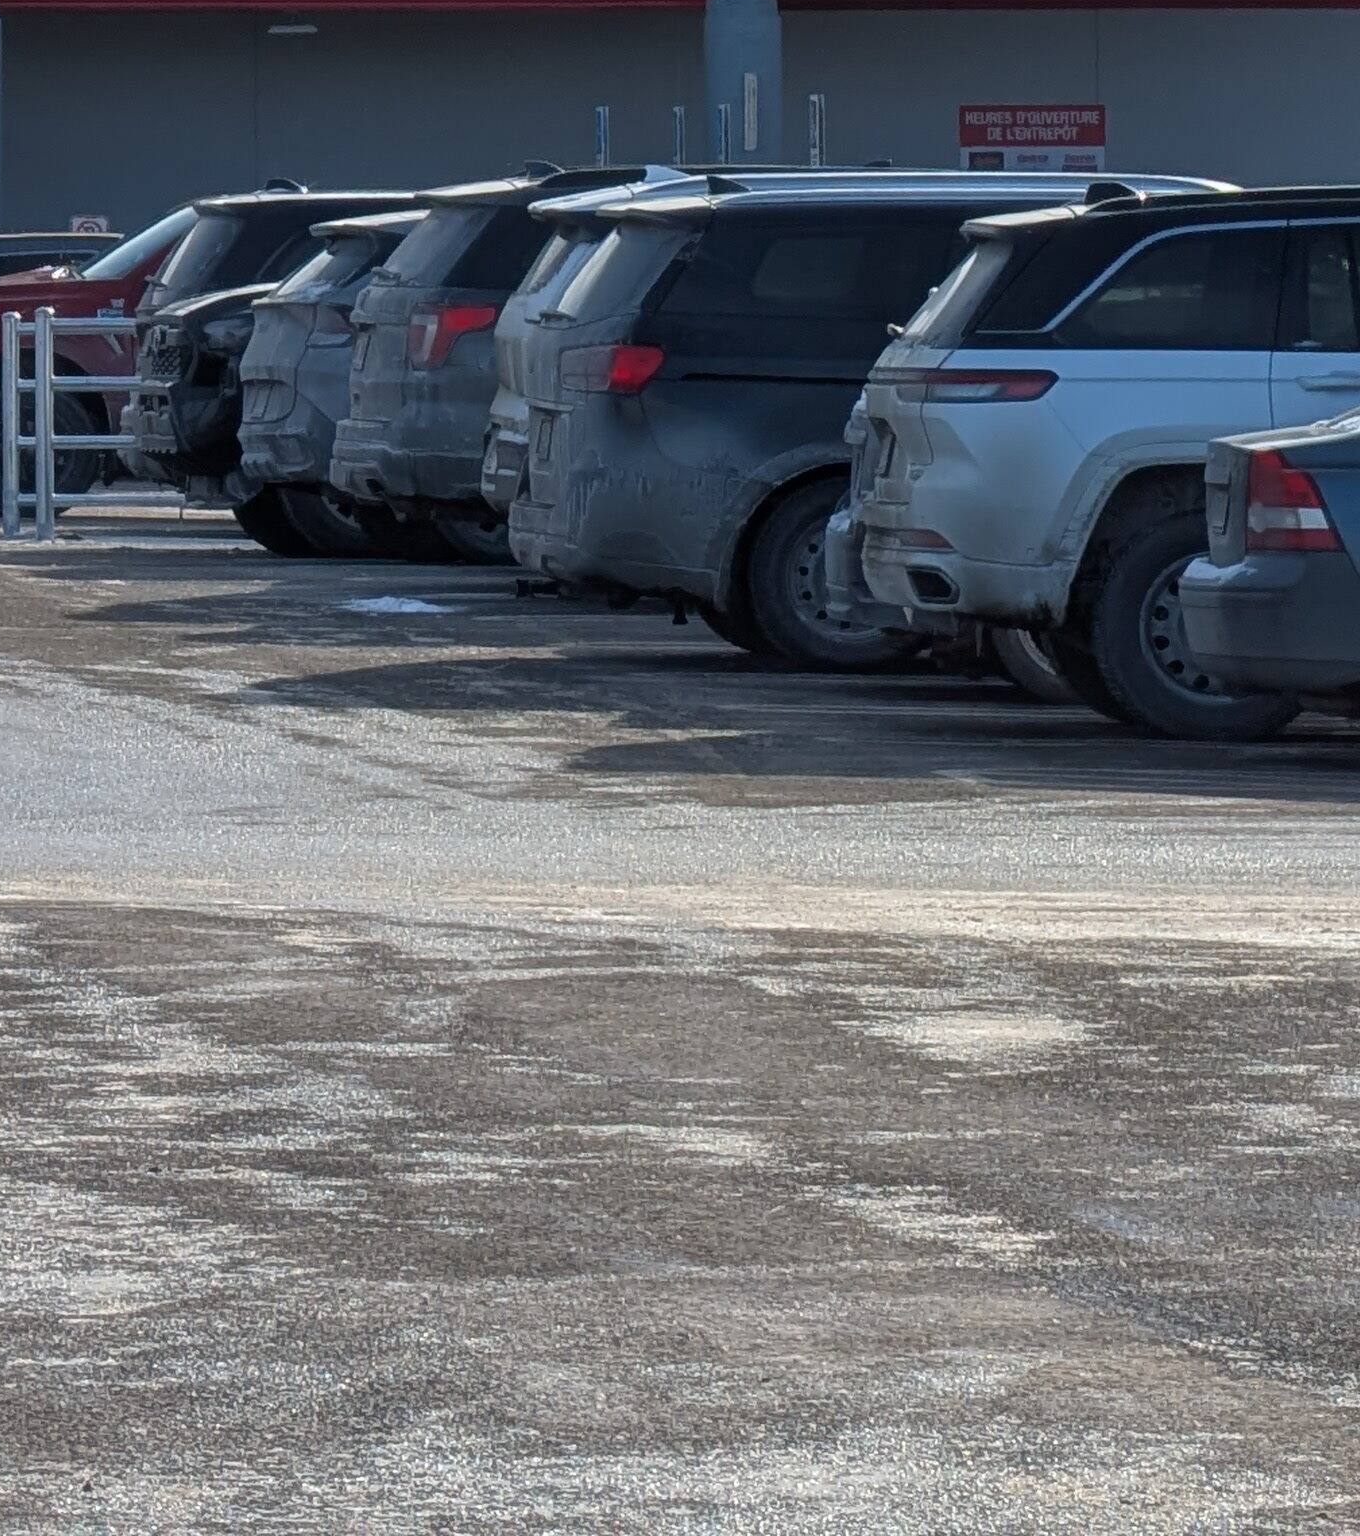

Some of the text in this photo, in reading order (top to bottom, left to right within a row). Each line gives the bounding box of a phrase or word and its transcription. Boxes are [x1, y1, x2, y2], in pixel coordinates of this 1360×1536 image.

[965, 110, 1100, 125] HEURES D'OUVERTURE
[987, 126, 1003, 141] DE
